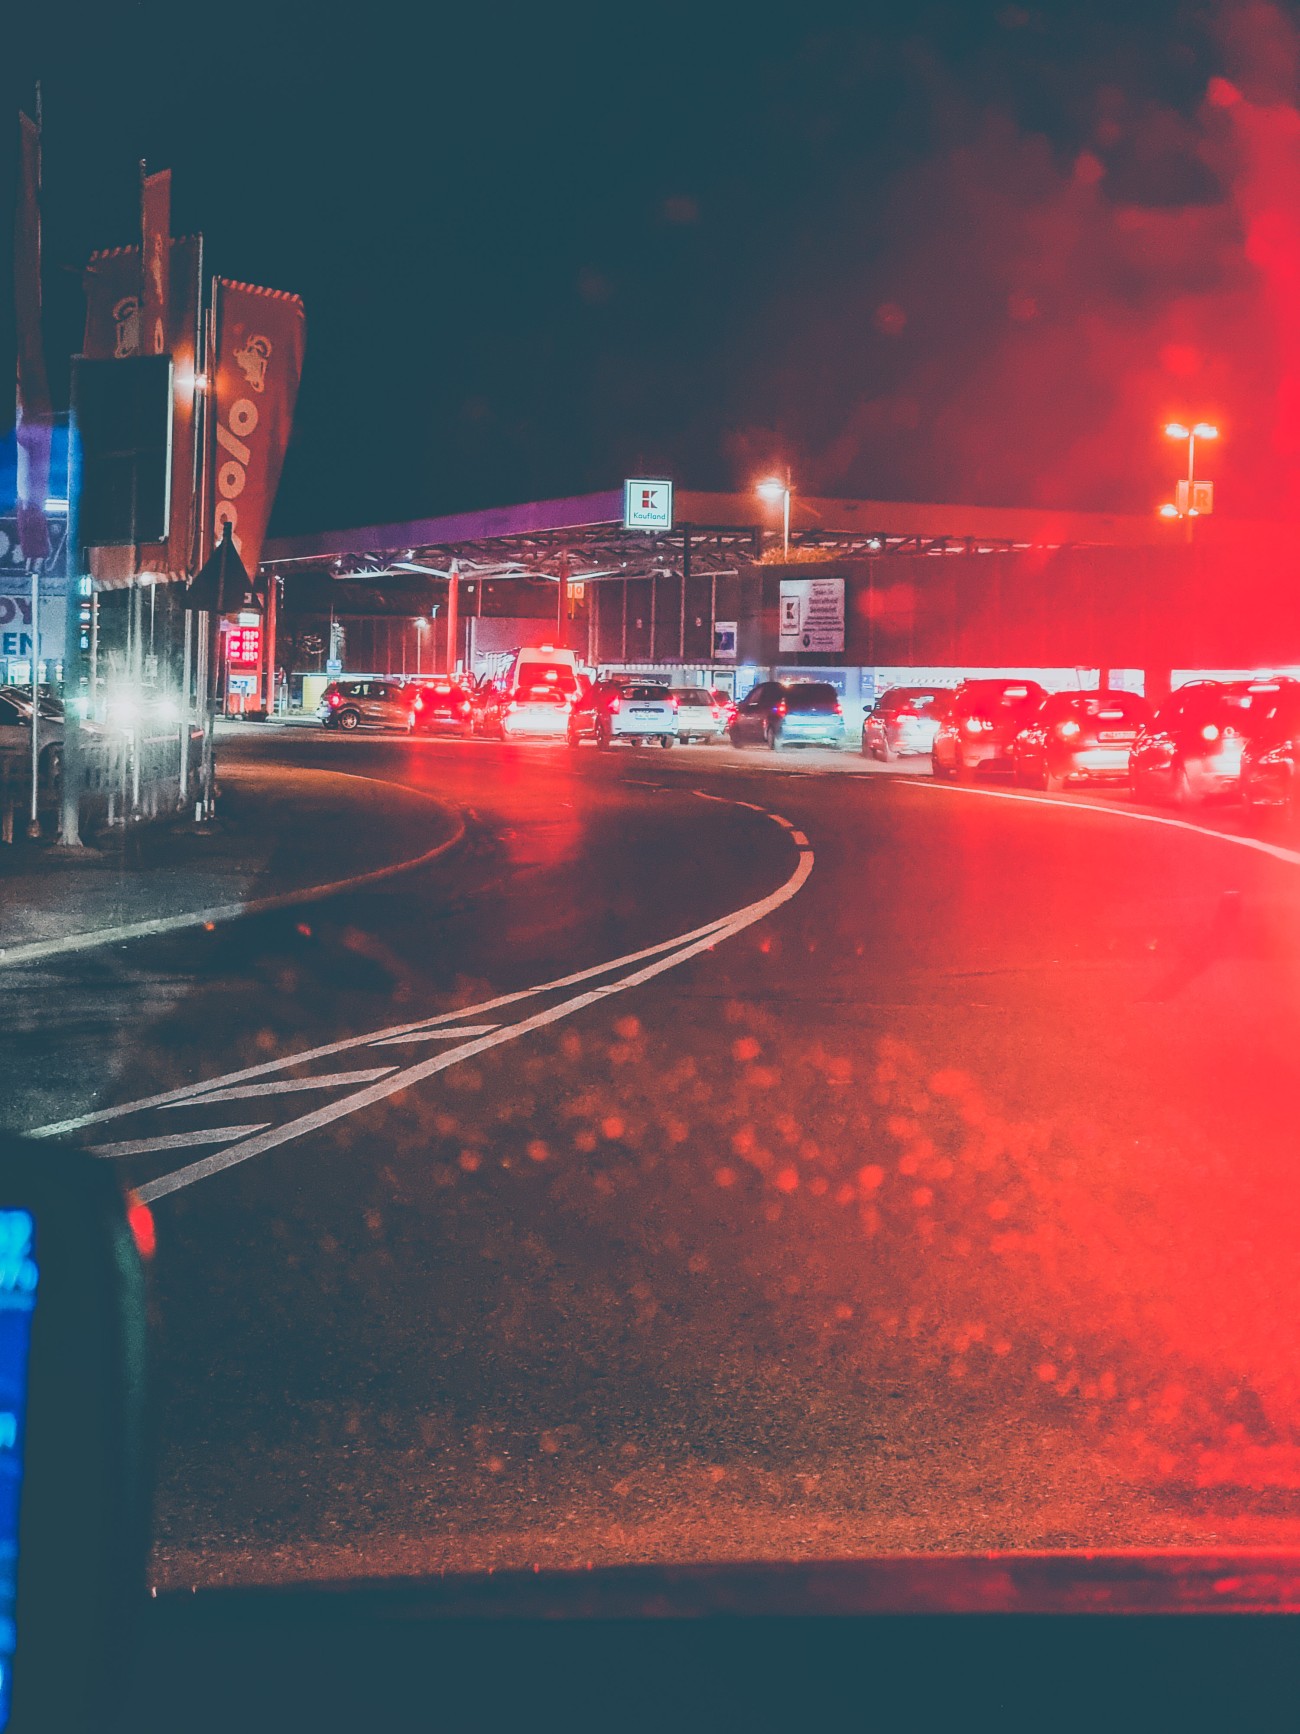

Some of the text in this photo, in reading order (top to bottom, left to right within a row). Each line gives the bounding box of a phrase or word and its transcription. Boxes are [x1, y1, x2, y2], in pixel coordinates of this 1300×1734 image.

[642, 490, 658, 508] K
[1196, 489, 1209, 507] R
[633, 512, 666, 520] Kaufland
